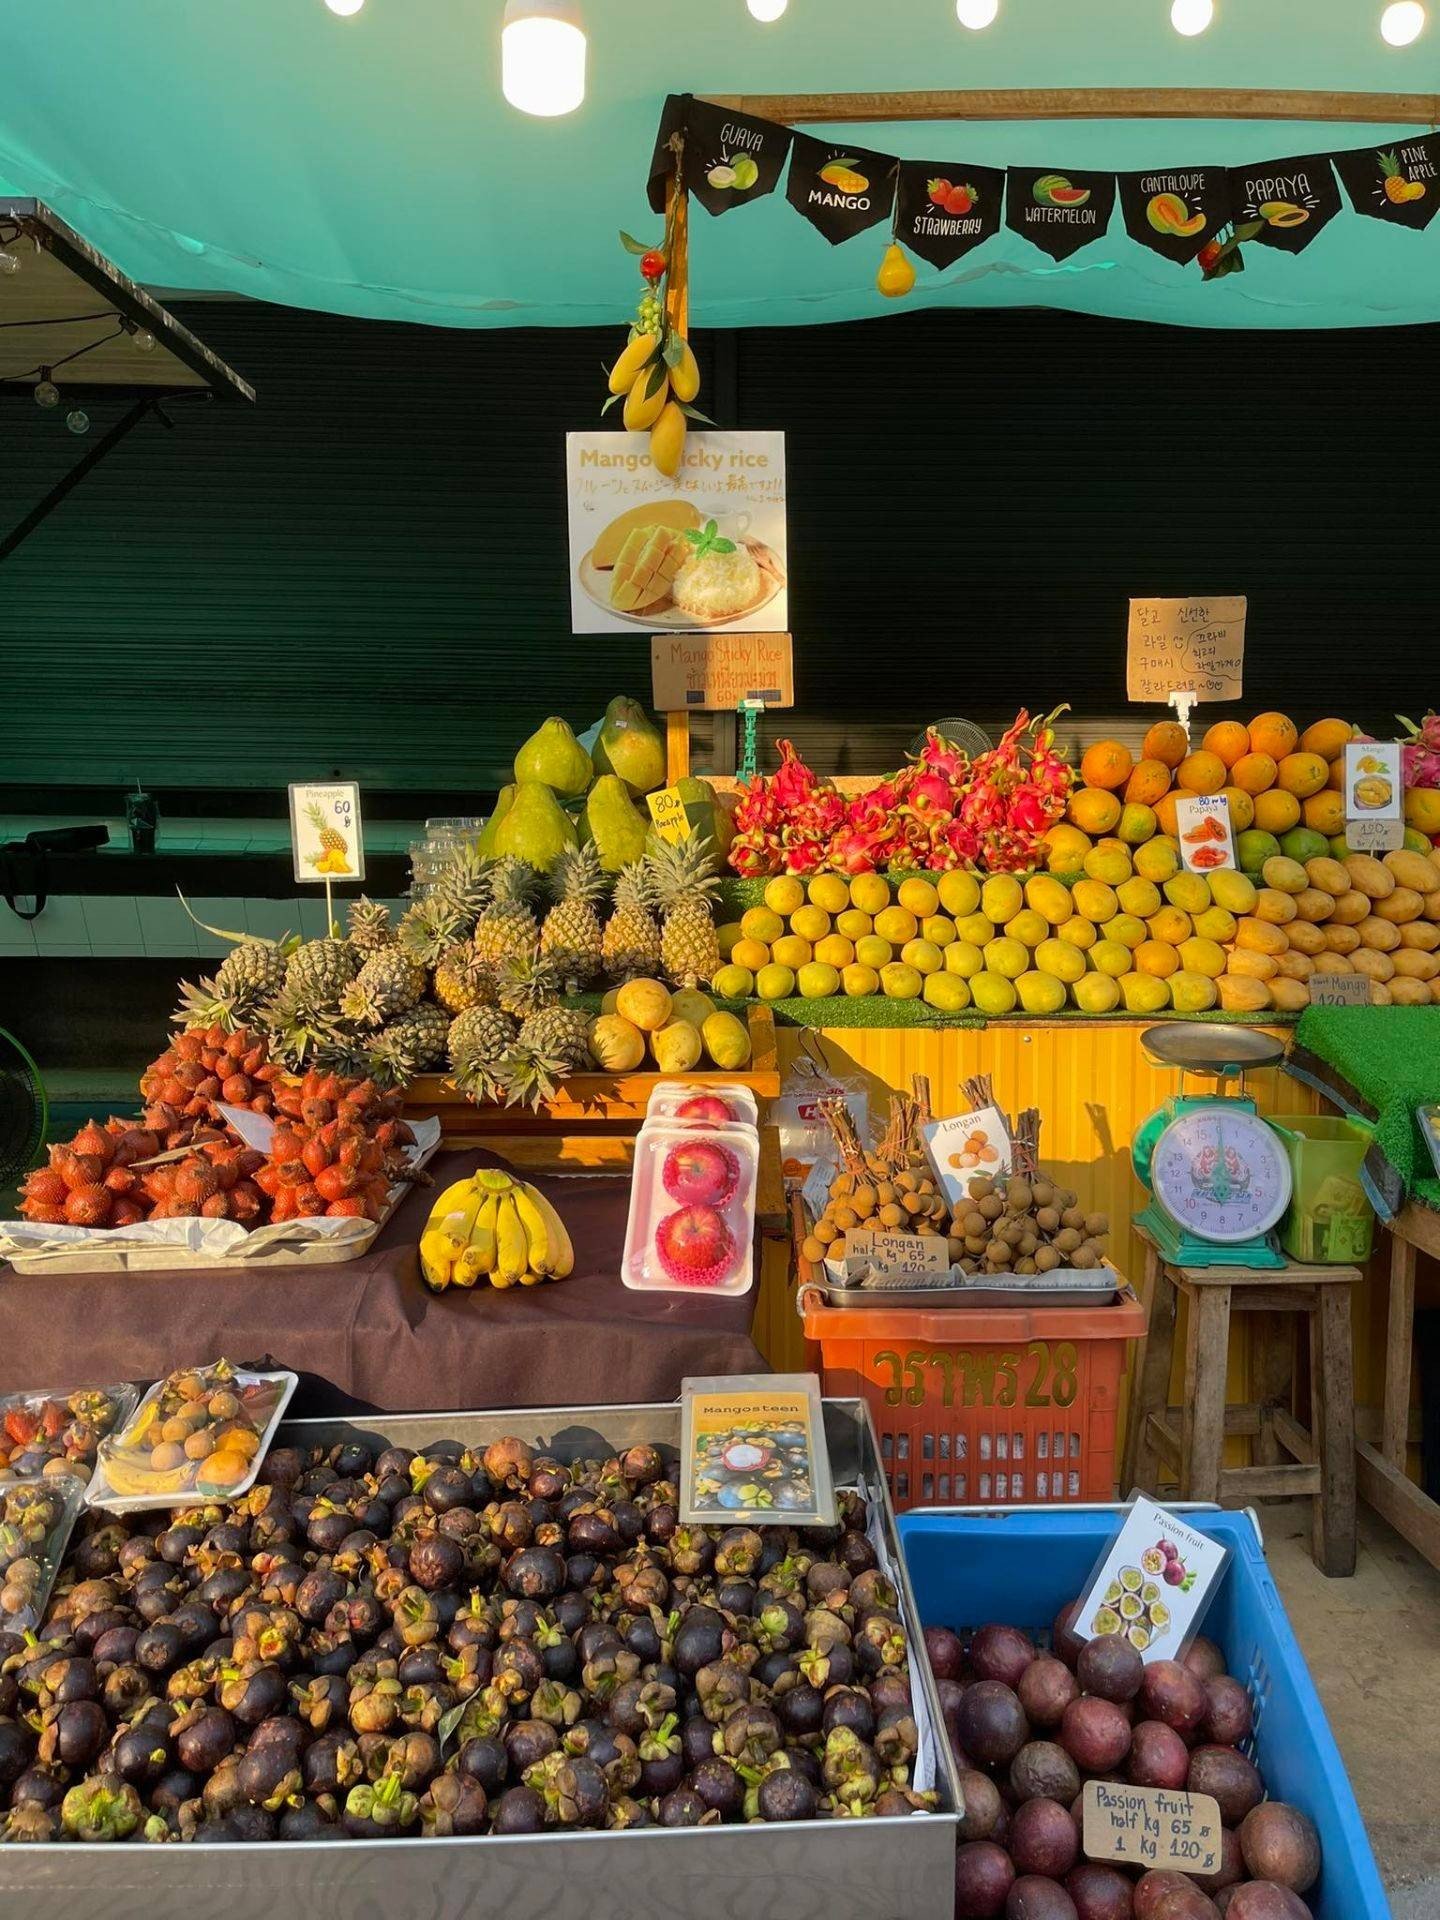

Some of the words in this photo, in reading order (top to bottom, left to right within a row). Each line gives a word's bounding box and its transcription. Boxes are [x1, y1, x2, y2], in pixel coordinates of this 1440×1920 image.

[720, 122, 764, 151] GUAVA
[1400, 145, 1428, 165] PINE
[1407, 161, 1439, 182] APPLE
[1140, 173, 1206, 193] CANTALOUPE
[1245, 173, 1311, 200] PAPAYA
[808, 189, 871, 211] MANGO
[1025, 207, 1097, 225] WATERMELON
[580, 449, 652, 471] Mango
[681, 449, 724, 472] icky
[730, 450, 769, 468] rice
[1137, 607, 1161, 627] 달고
[1177, 606, 1211, 624] 신선한
[715, 639, 753, 666] Sticky
[757, 639, 783, 661] Rice
[1139, 657, 1174, 672] 구매시
[305, 789, 345, 799] Pineapple
[334, 800, 351, 814] 60
[1331, 976, 1367, 996] Mango
[942, 1115, 982, 1132] Longan
[1197, 1129, 1208, 1140] 15
[1249, 1140, 1256, 1148] 2
[1174, 1153, 1183, 1161] 13
[1260, 1155, 1267, 1164] 3
[1170, 1169, 1180, 1177] 12
[1254, 1188, 1262, 1198] 5
[1184, 1198, 1196, 1209] 10
[1251, 1204, 1259, 1212] 6
[1200, 1211, 1207, 1220] 9
[1219, 1216, 1226, 1224] 8
[1237, 1212, 1244, 1221] 7
[872, 1232, 924, 1253] Longan
[853, 1244, 876, 1256] half
[909, 1250, 925, 1261] 65
[703, 1404, 800, 1415] Mangosteen
[1152, 1512, 1184, 1538] Passion
[1184, 1533, 1207, 1551] fruit
[1096, 1785, 1146, 1812] Passion
[1155, 1791, 1194, 1816] fruit
[1110, 1811, 1139, 1829] half
[1170, 1819, 1192, 1834] 65
[1114, 1836, 1126, 1851] 1
[1169, 1838, 1200, 1860] 120
